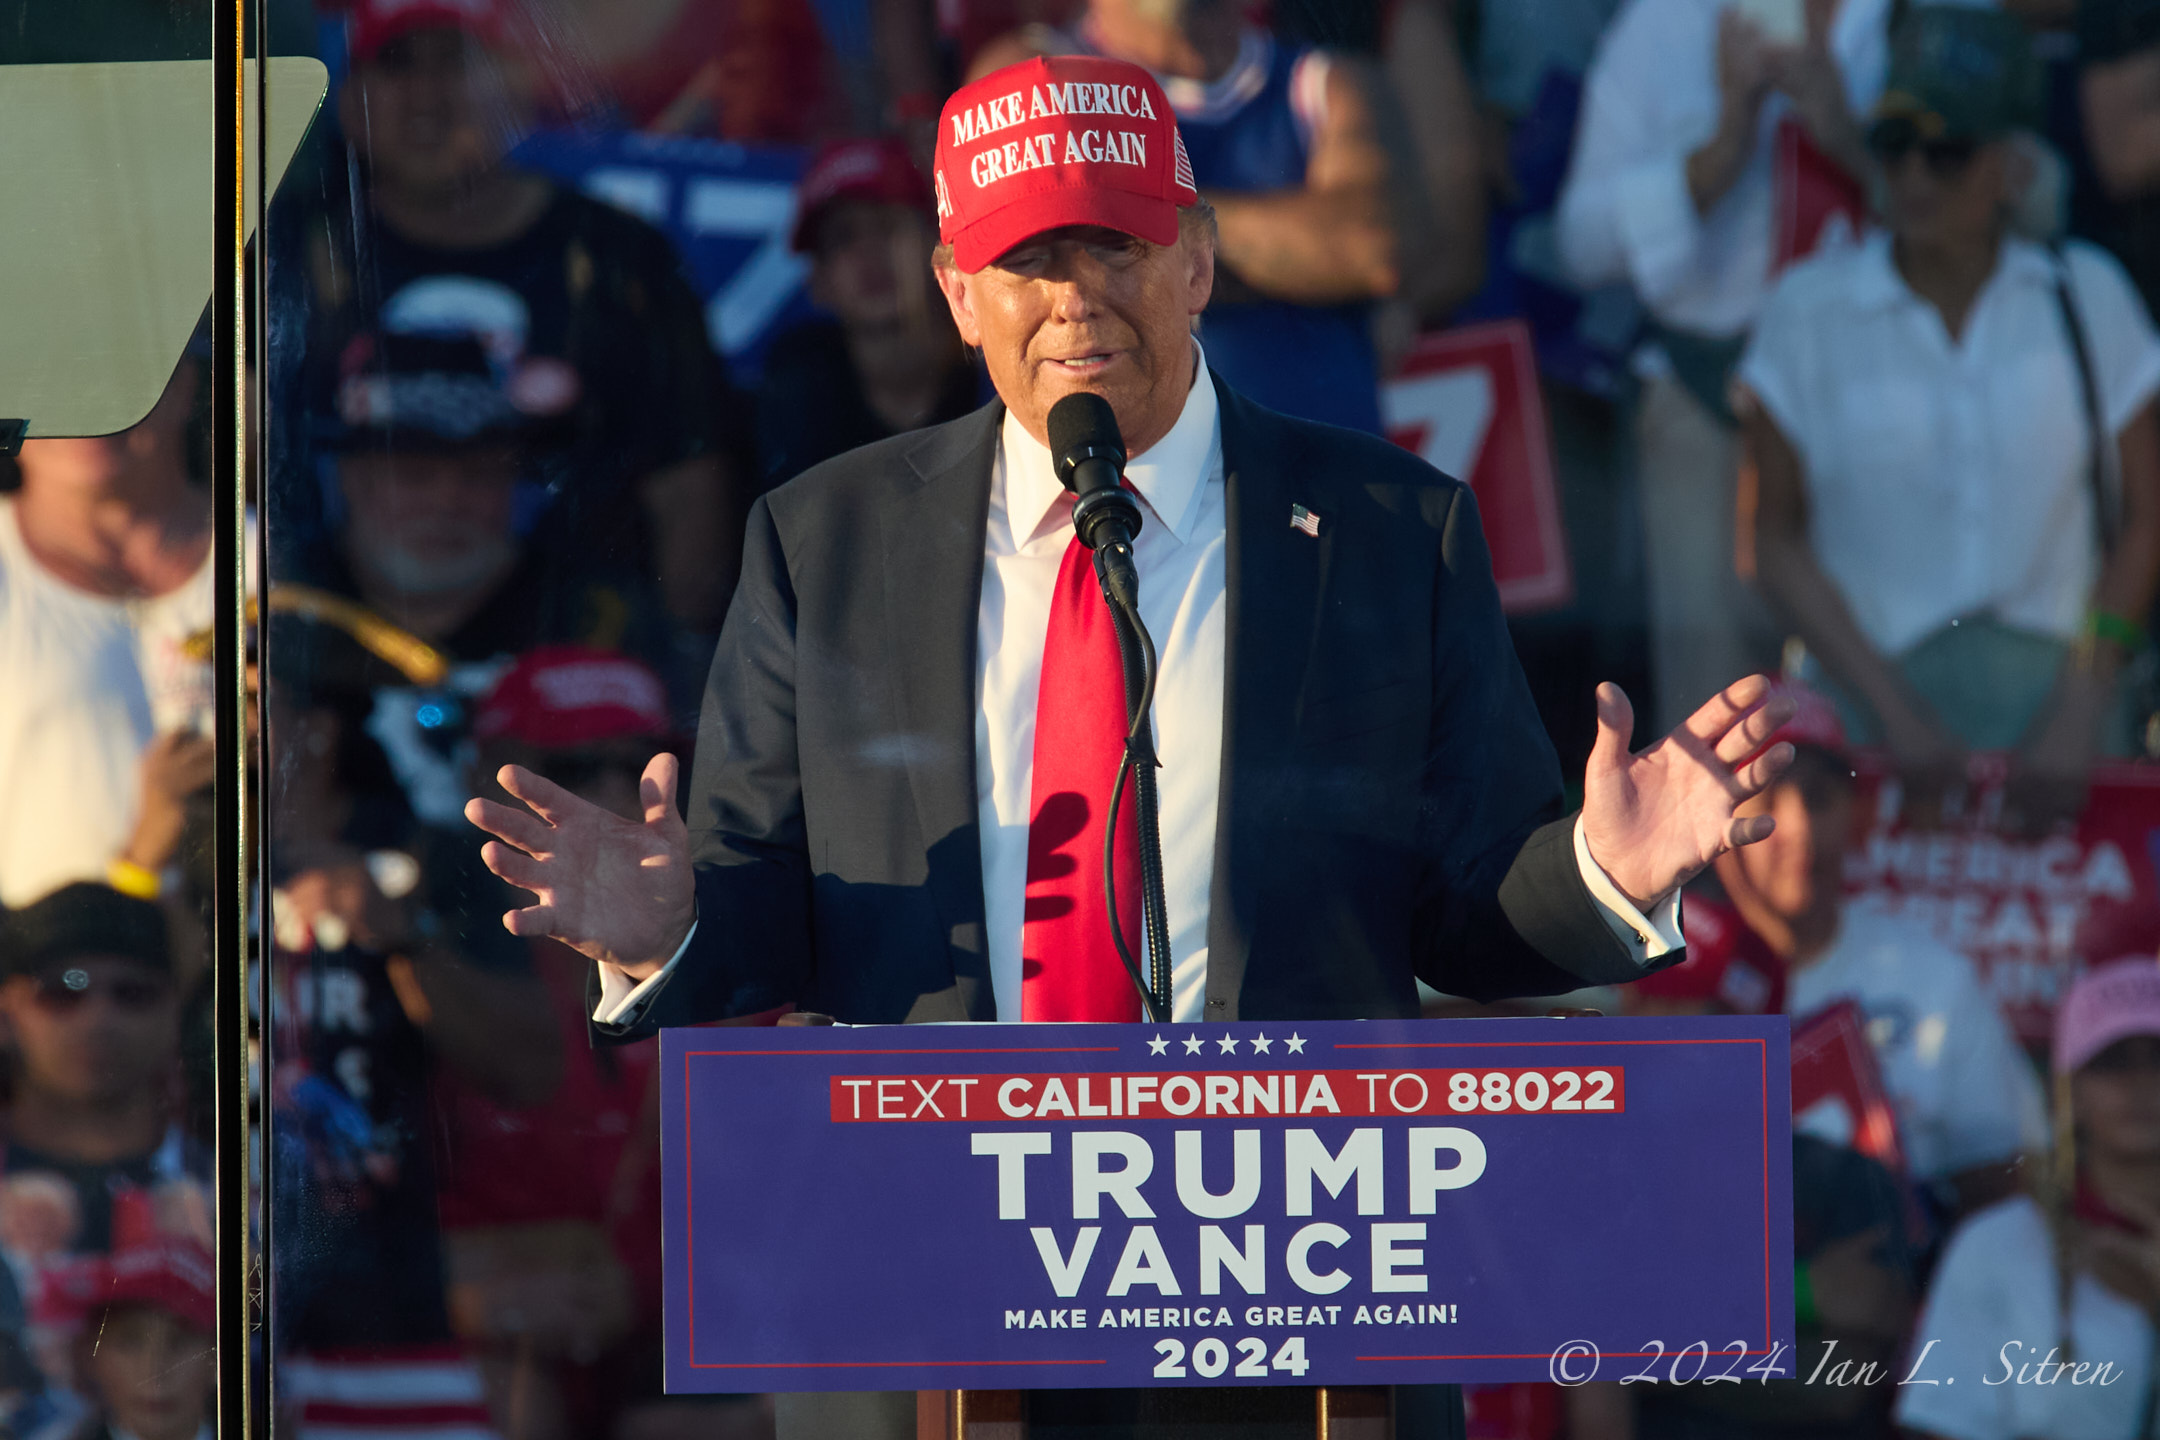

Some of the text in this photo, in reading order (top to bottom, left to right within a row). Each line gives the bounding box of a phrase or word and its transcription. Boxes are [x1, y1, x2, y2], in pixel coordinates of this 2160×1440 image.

[951, 81, 1158, 148] MAKE AMERICA
[970, 129, 1147, 188] GREAT AGAIN
[841, 1071, 1616, 1119] TEXT CALIFORNIA TO 88022
[970, 1126, 1488, 1221] TRUMP
[1030, 1221, 1429, 1298] VANCE
[1004, 1303, 1459, 1330] MAKE AMERICA GREAT AGAIN!
[1152, 1337, 1310, 1379] 2024
